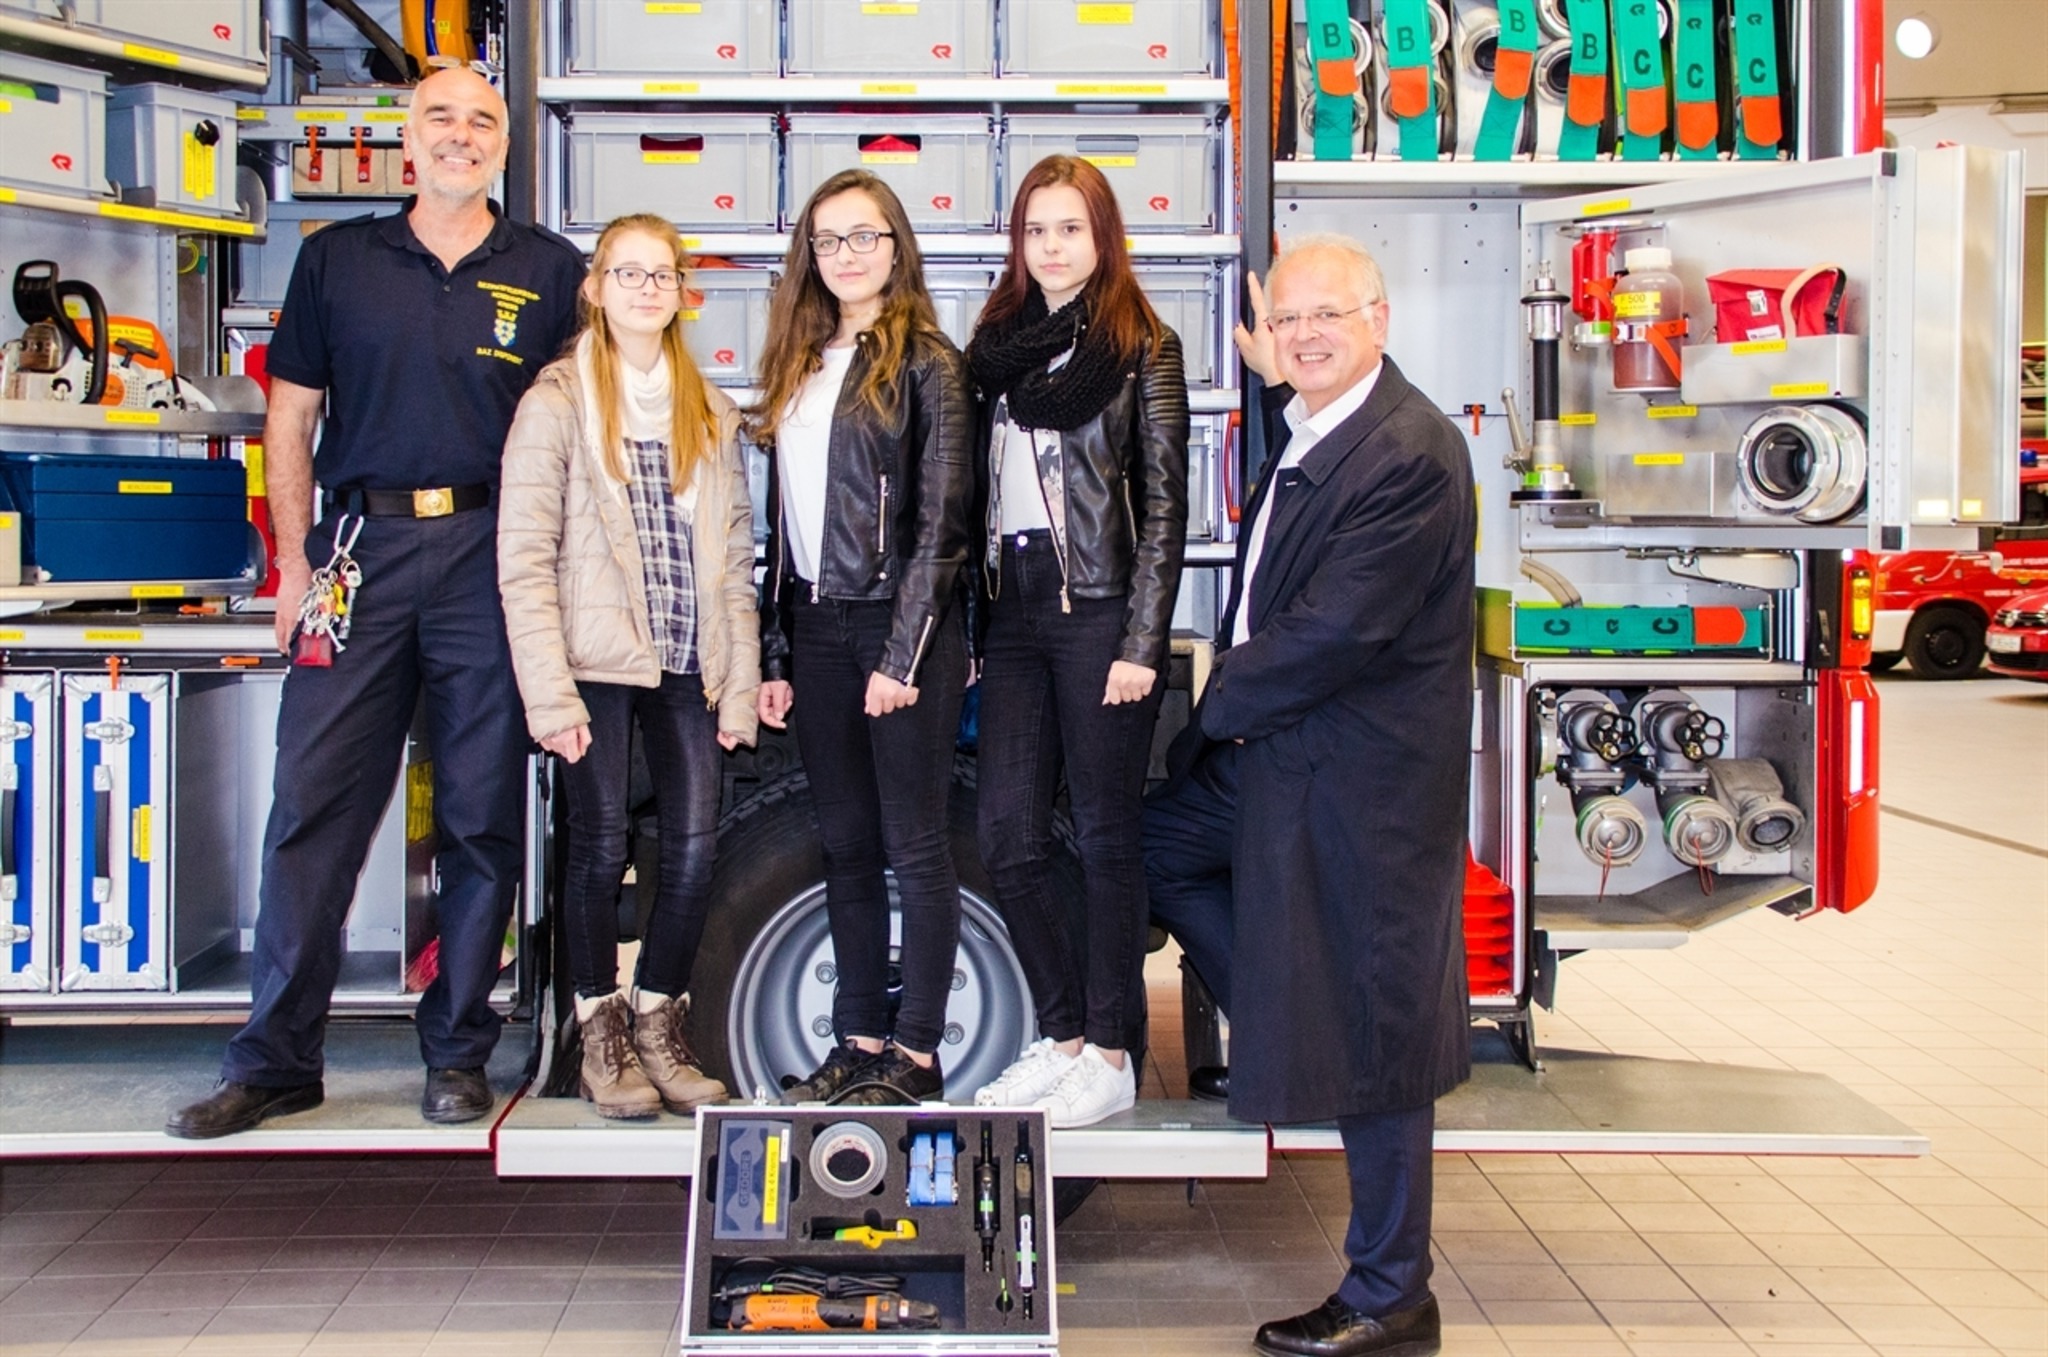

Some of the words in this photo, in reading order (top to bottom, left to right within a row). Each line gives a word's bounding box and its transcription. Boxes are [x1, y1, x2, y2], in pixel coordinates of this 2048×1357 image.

[1509, 9, 1527, 33] B
[1322, 22, 1342, 48] B
[1396, 26, 1416, 52] B
[1581, 33, 1598, 60] B
[1633, 49, 1652, 75] C
[1748, 58, 1767, 84] C
[1686, 63, 1704, 89] C
[1628, 293, 1646, 303] 500
[1543, 618, 1571, 636] C
[1652, 616, 1680, 635] C
